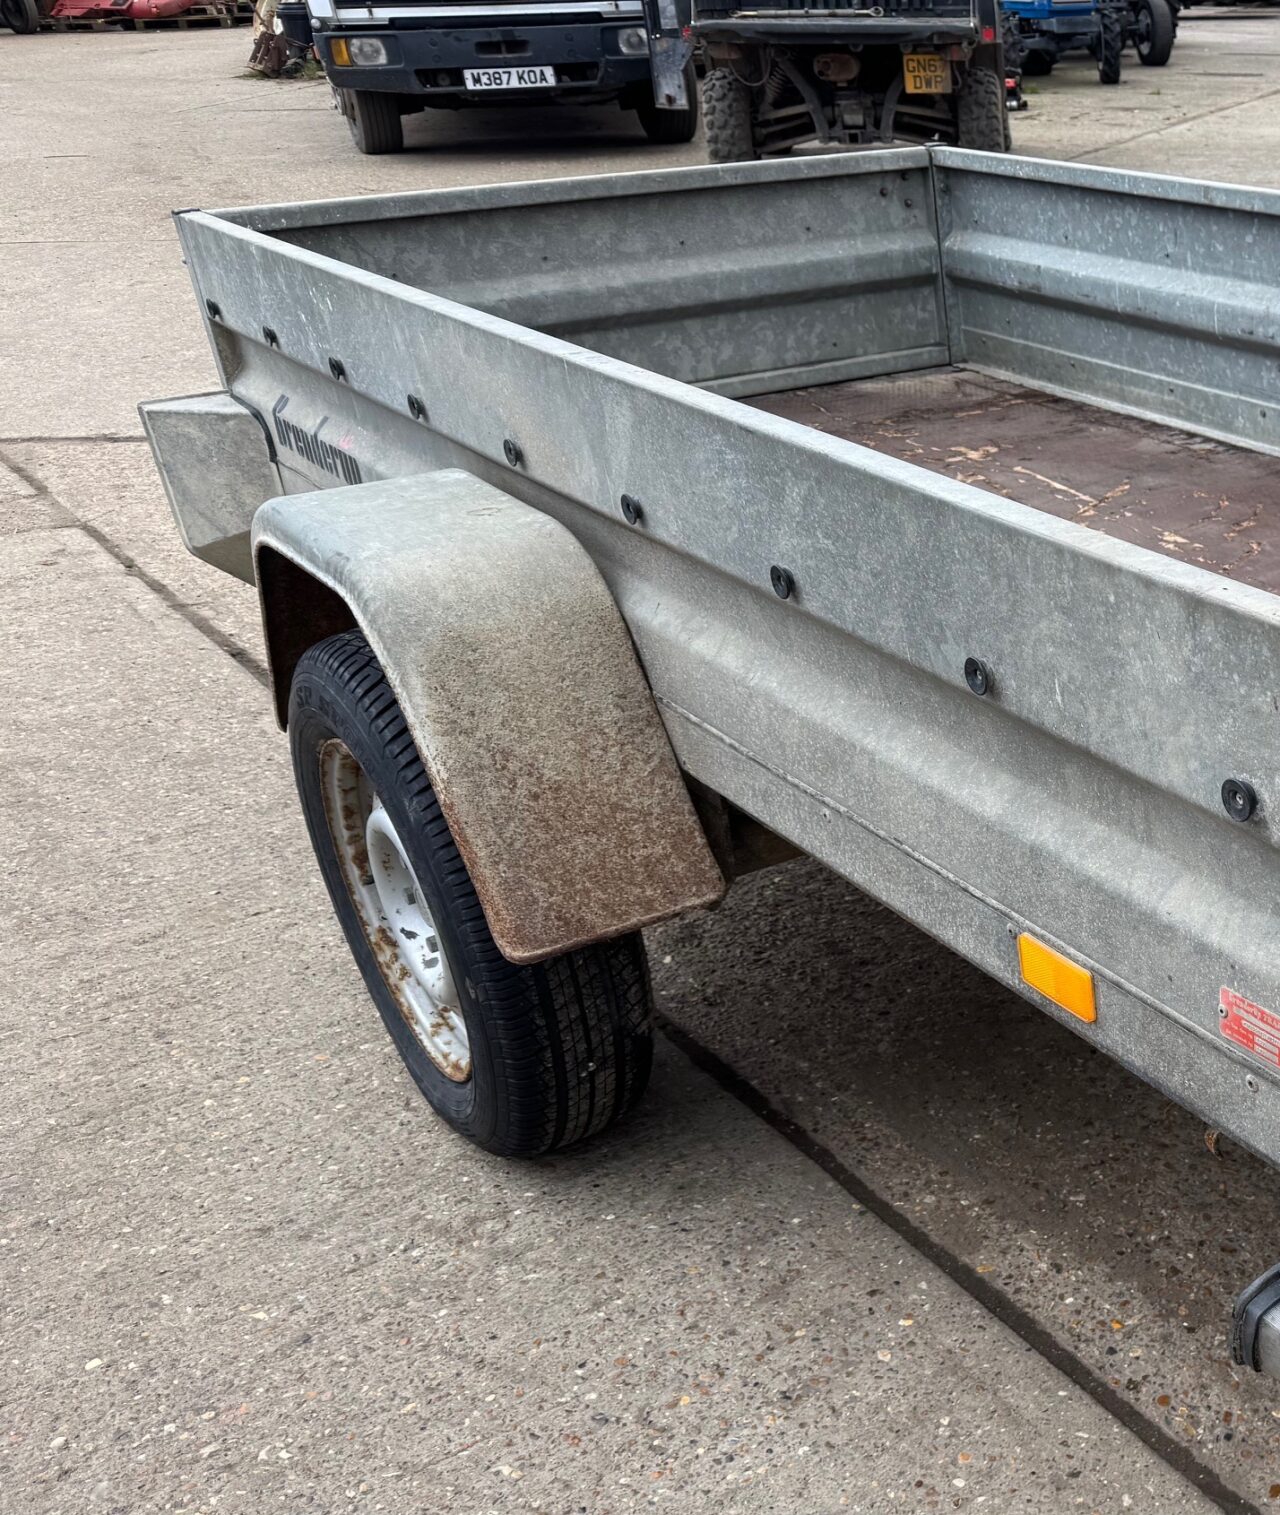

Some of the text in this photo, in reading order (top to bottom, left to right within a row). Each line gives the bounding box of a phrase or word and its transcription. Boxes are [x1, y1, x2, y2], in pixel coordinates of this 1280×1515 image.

[470, 69, 548, 87] M387 KOA
[913, 75, 943, 89] DWP
